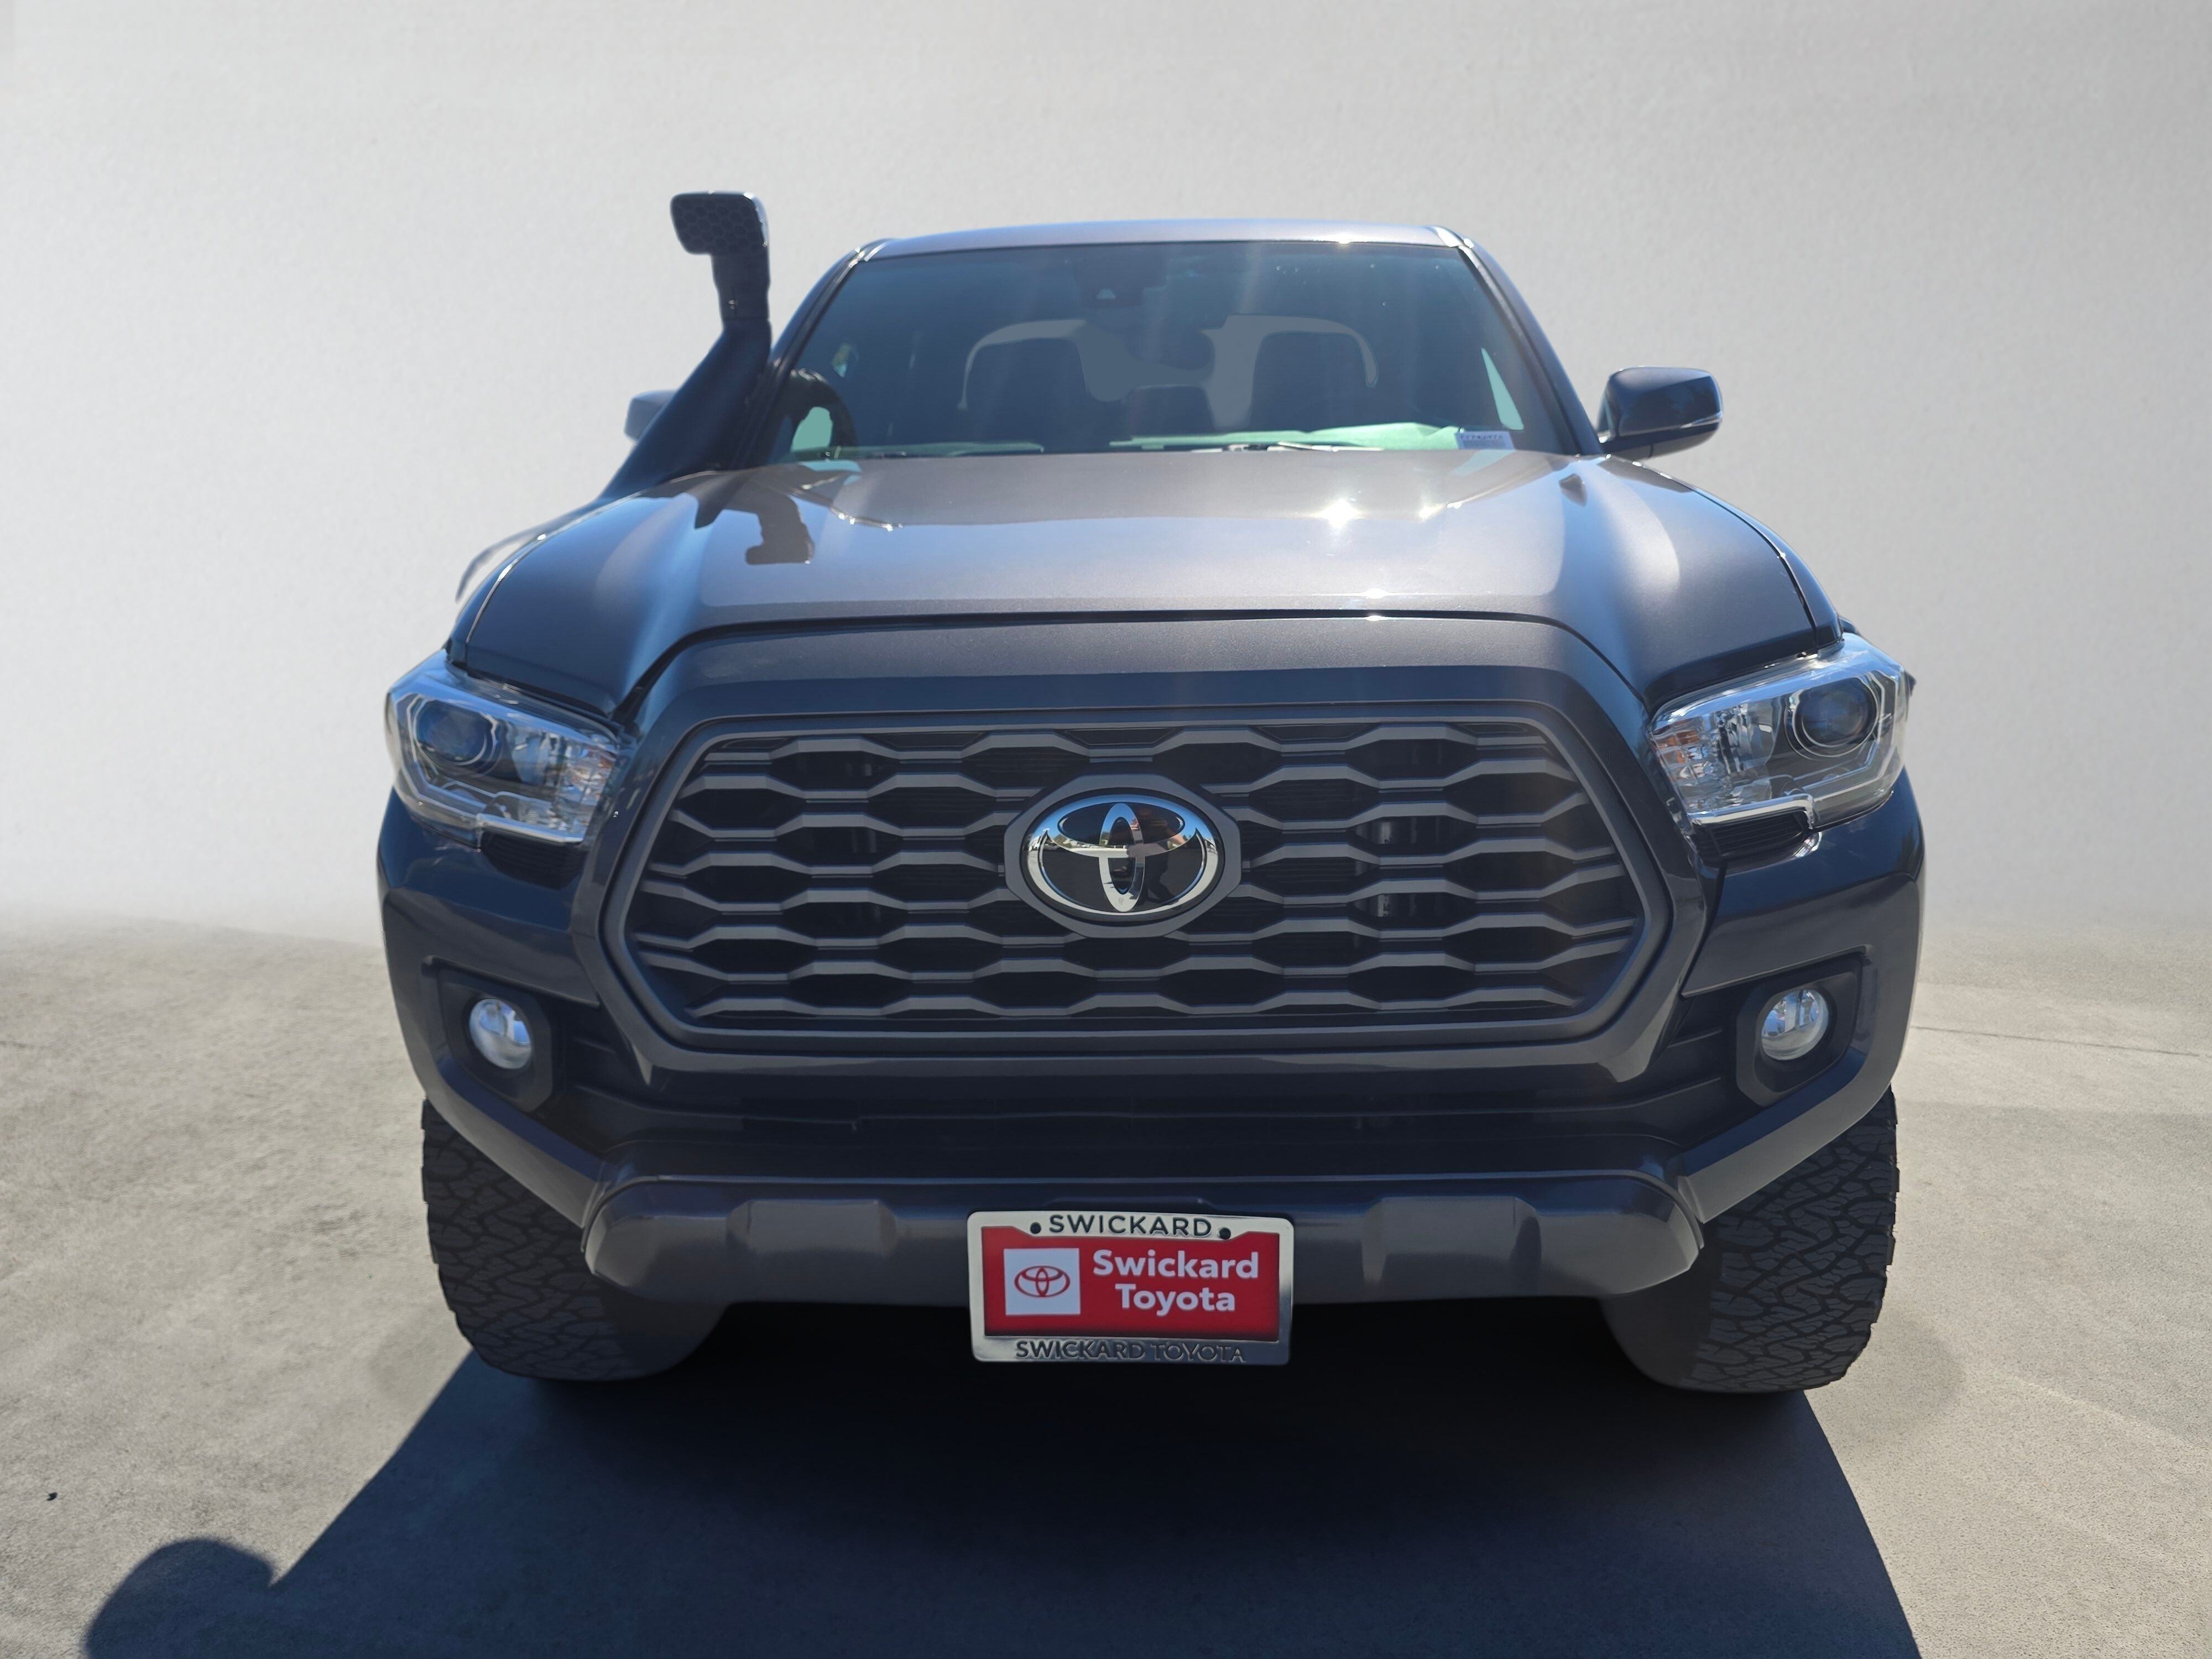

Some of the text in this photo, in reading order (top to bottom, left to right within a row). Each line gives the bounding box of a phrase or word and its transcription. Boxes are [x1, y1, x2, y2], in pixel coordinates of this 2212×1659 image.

[1049, 1214, 1212, 1237] SWICKARD
[1093, 1249, 1259, 1279] Swickard
[1114, 1283, 1236, 1316] Toyota
[1015, 1339, 1246, 1364] SWICKARD TOYOTA
